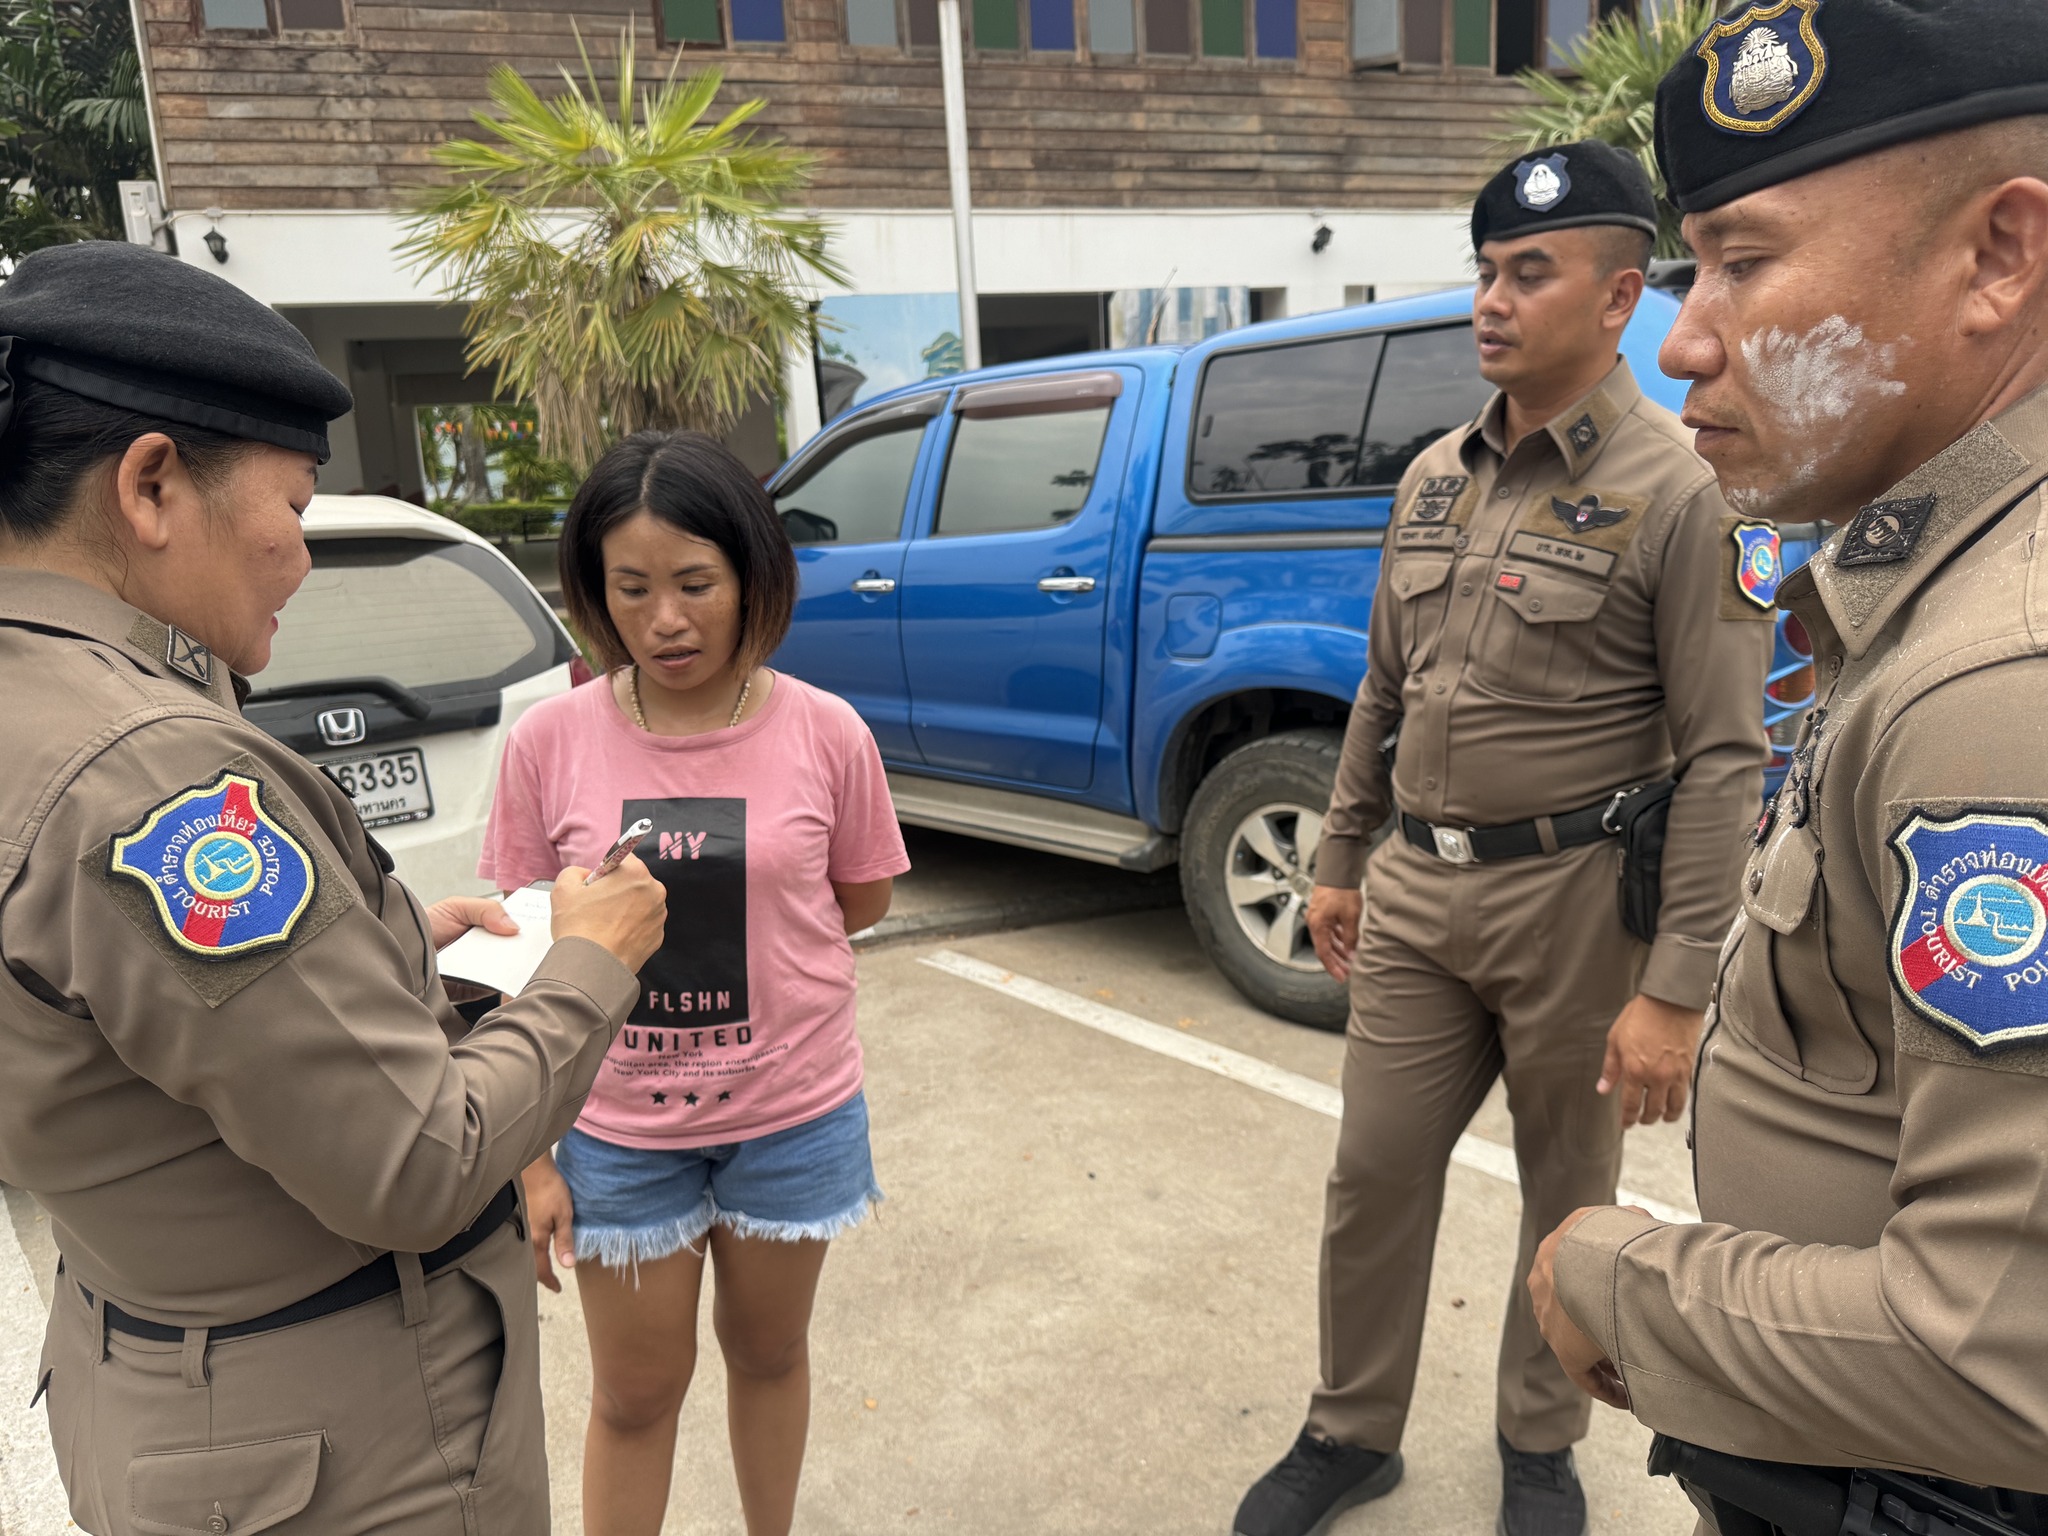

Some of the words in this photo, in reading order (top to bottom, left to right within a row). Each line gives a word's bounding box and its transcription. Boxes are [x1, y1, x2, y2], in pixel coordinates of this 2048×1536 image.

[338, 755, 419, 793] 6335
[156, 804, 258, 886] ตำรวจท่องเที่ยว
[658, 830, 707, 861] NY
[258, 835, 281, 897] POLICE
[171, 886, 252, 919] TOURIST
[1920, 909, 1982, 990] TOURIST
[648, 990, 731, 1013] FLSHN
[624, 1025, 753, 1053] UNITED
[683, 1050, 703, 1059] York
[604, 1054, 645, 1068] ropolitan
[674, 1060, 689, 1068] the
[691, 1059, 722, 1069] region
[725, 1042, 789, 1066] encompassing
[613, 1066, 634, 1076] New
[637, 1068, 660, 1076] York
[663, 1069, 680, 1078] City
[683, 1069, 700, 1077] and
[702, 1069, 714, 1077] its
